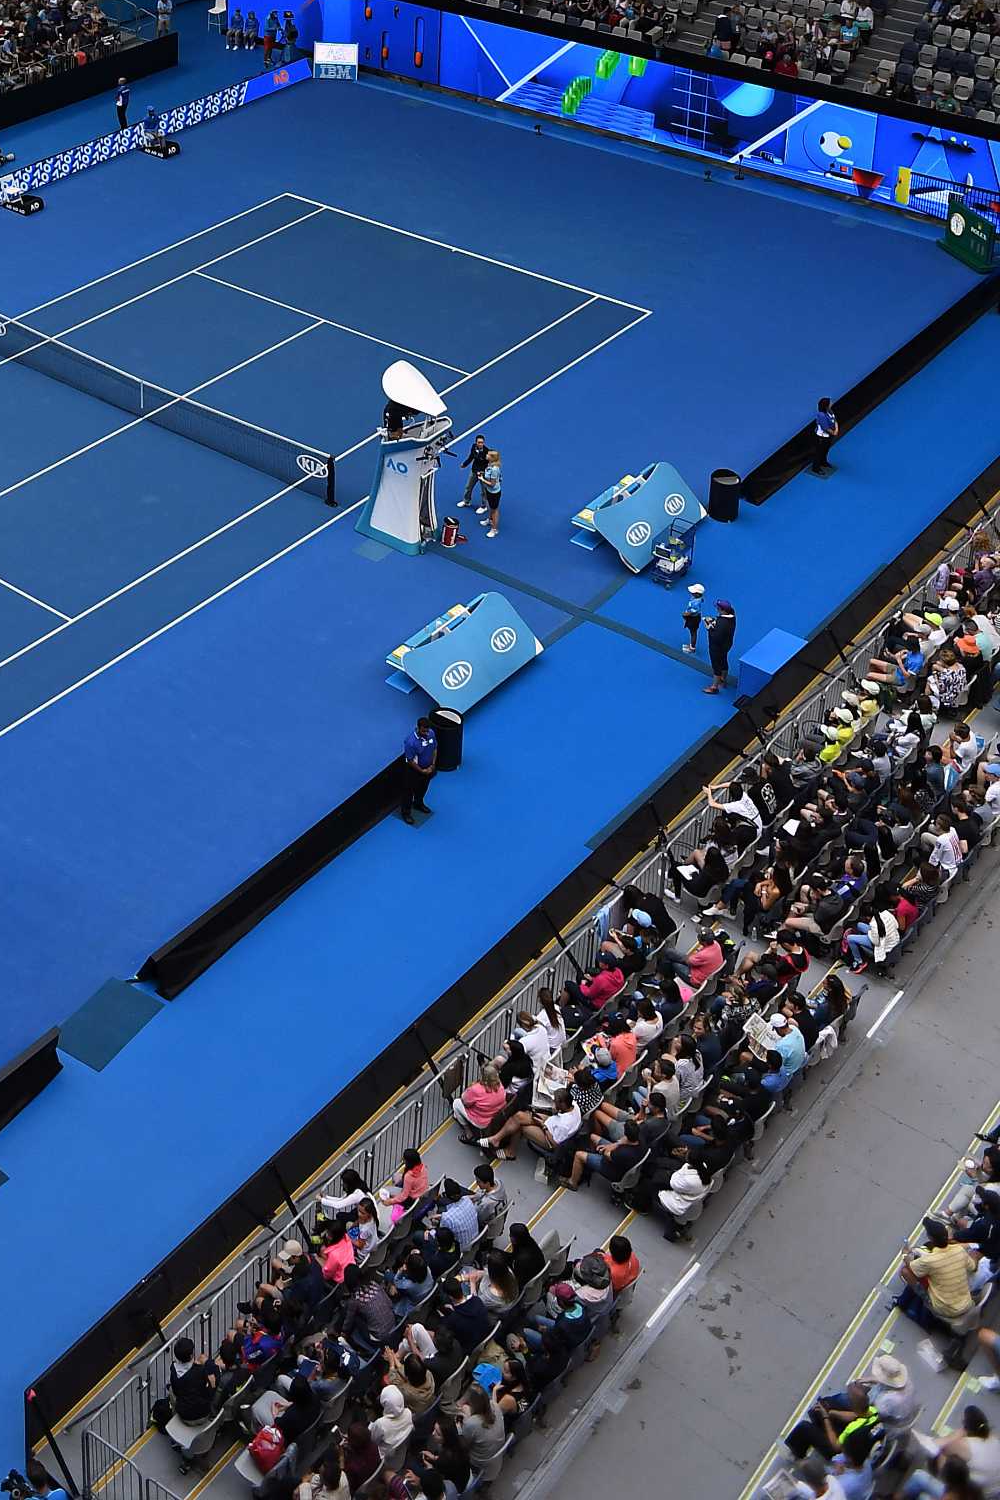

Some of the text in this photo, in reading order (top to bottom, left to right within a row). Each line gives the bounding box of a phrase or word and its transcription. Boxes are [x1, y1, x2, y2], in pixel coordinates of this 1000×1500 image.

[319, 64, 352, 80] IBM
[386, 458, 408, 474] AO
[667, 496, 683, 514] KIA
[628, 524, 649, 544] KIA
[492, 630, 515, 650] KIA
[444, 665, 469, 687] KIA
